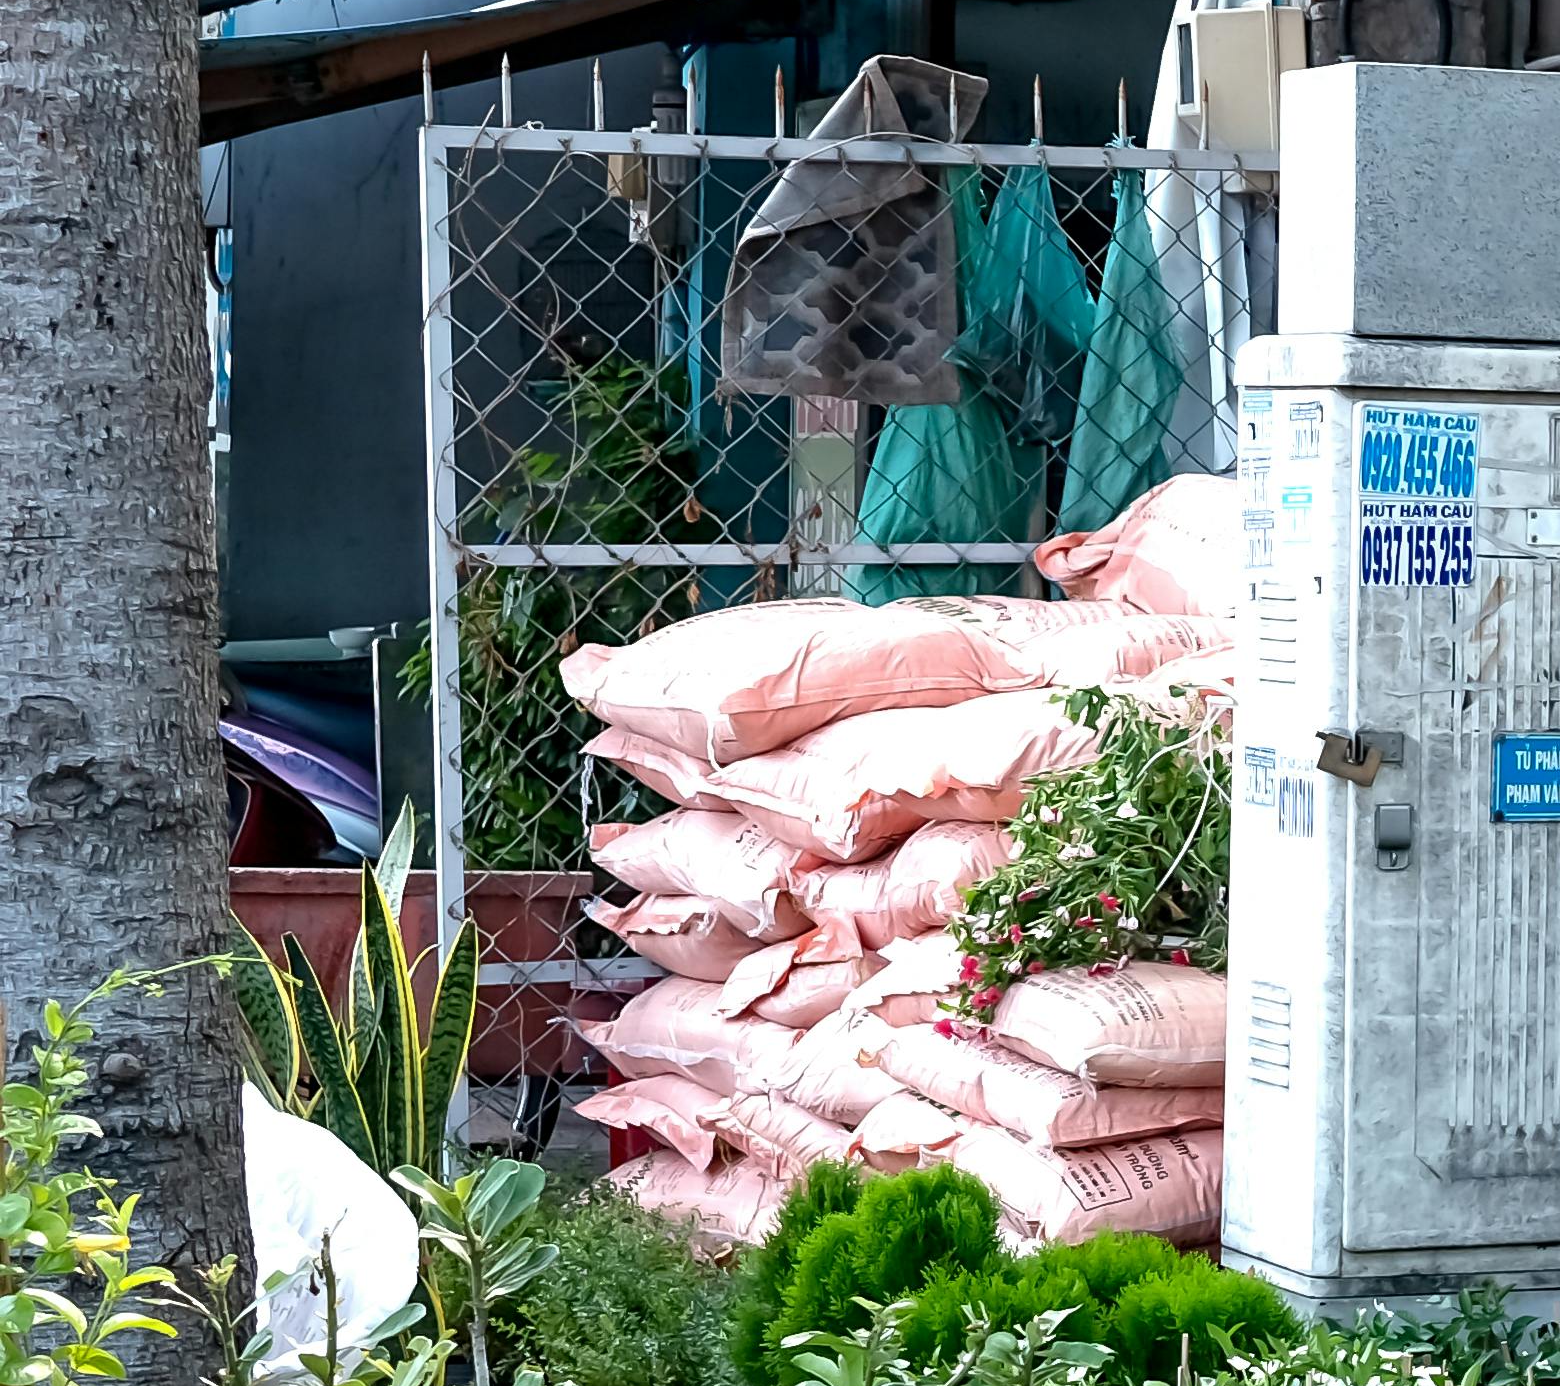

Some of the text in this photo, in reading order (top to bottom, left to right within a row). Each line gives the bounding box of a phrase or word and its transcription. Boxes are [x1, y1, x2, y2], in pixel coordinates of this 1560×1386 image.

[1361, 430, 1475, 498] 0928.455.466
[1362, 525, 1473, 586] 0937.155.255
[1515, 743, 1531, 771] TỦ
[1506, 784, 1541, 808] PHẠM
